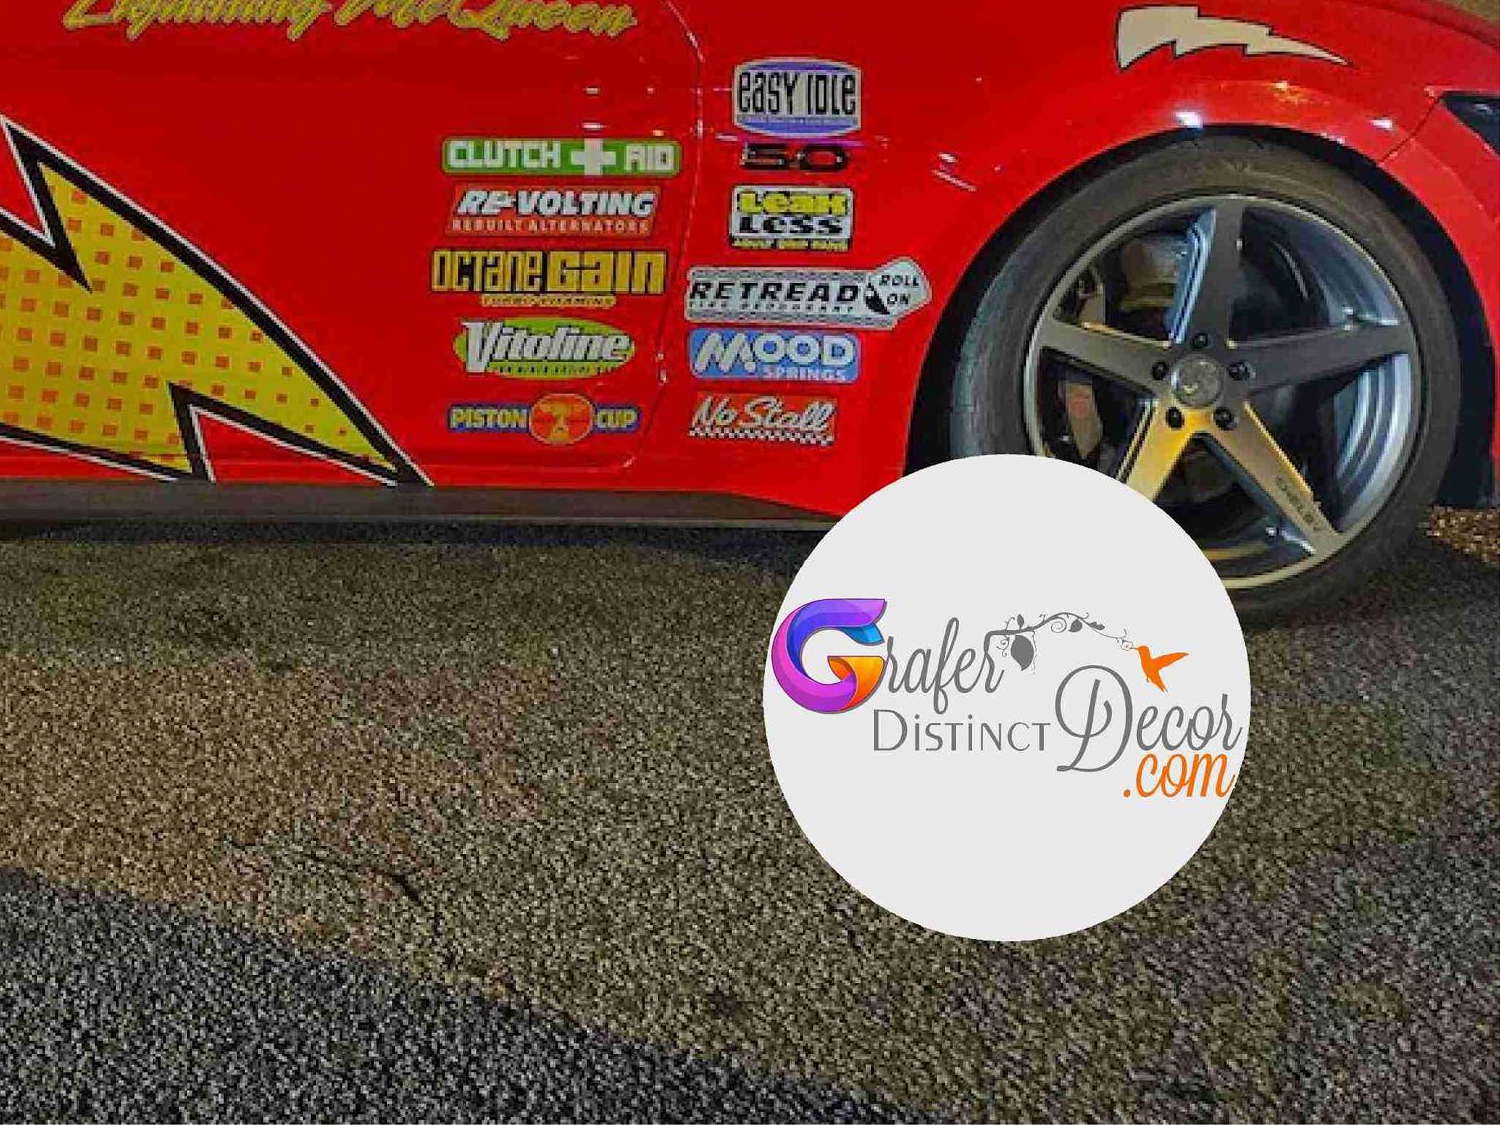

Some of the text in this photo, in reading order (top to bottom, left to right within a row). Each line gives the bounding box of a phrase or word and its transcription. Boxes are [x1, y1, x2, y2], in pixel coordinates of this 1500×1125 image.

[449, 140, 674, 172] CLUTCH AID
[457, 190, 656, 216] RE-VOLTING
[452, 218, 649, 234] REBUILT ALTERNATORS
[689, 274, 920, 302] RETREAD ROLL
[886, 291, 911, 306] ON
[461, 320, 632, 373] Vitoline
[694, 332, 854, 372] MOOD
[762, 366, 847, 381] SPRINGS
[450, 406, 639, 430] PISTON CUP
[691, 395, 836, 432] No Stall
